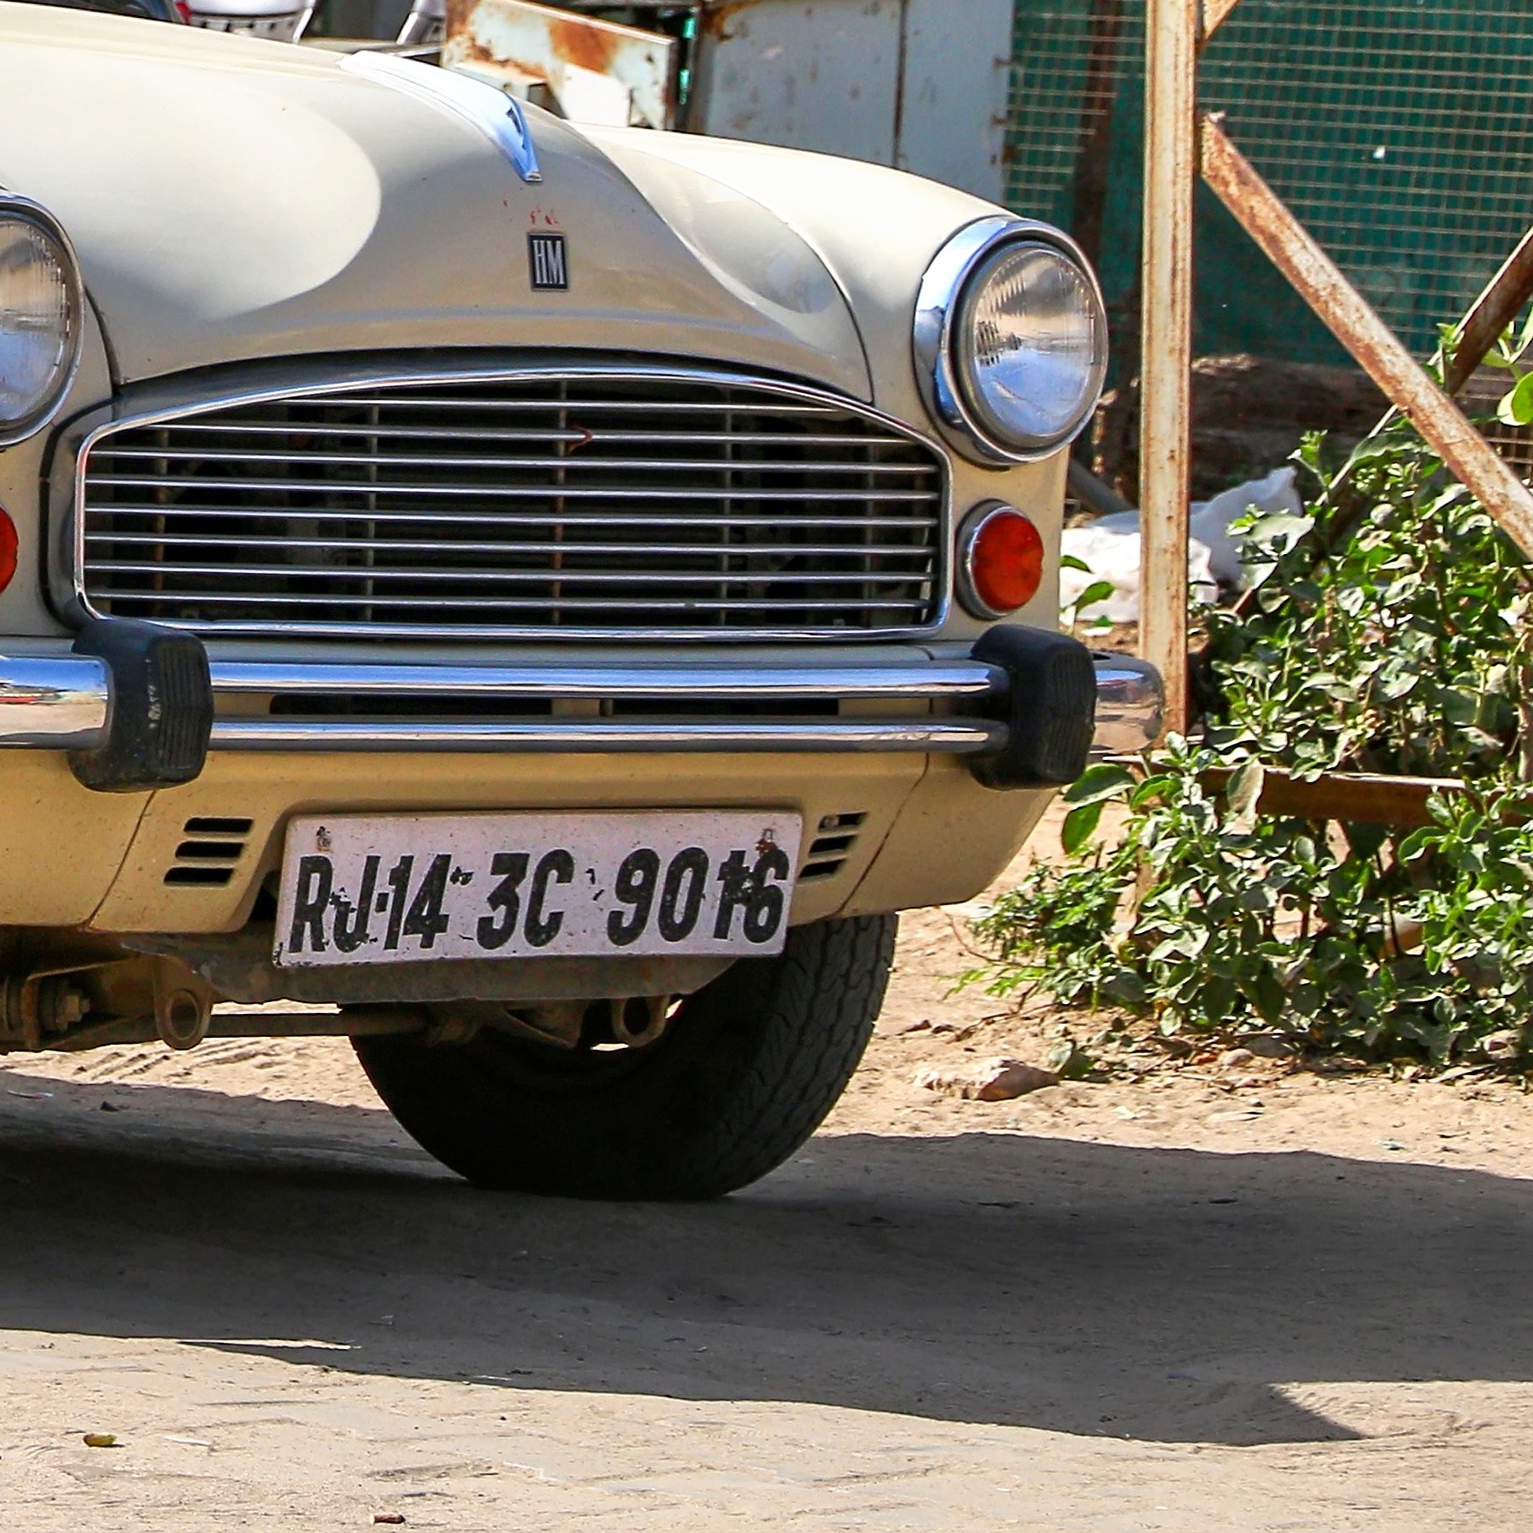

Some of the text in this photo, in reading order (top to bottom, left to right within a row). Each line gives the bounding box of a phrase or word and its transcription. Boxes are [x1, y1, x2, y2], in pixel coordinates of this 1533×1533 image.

[533, 240, 564, 284] HM
[476, 849, 575, 951] 3C
[607, 846, 790, 947] 9016
